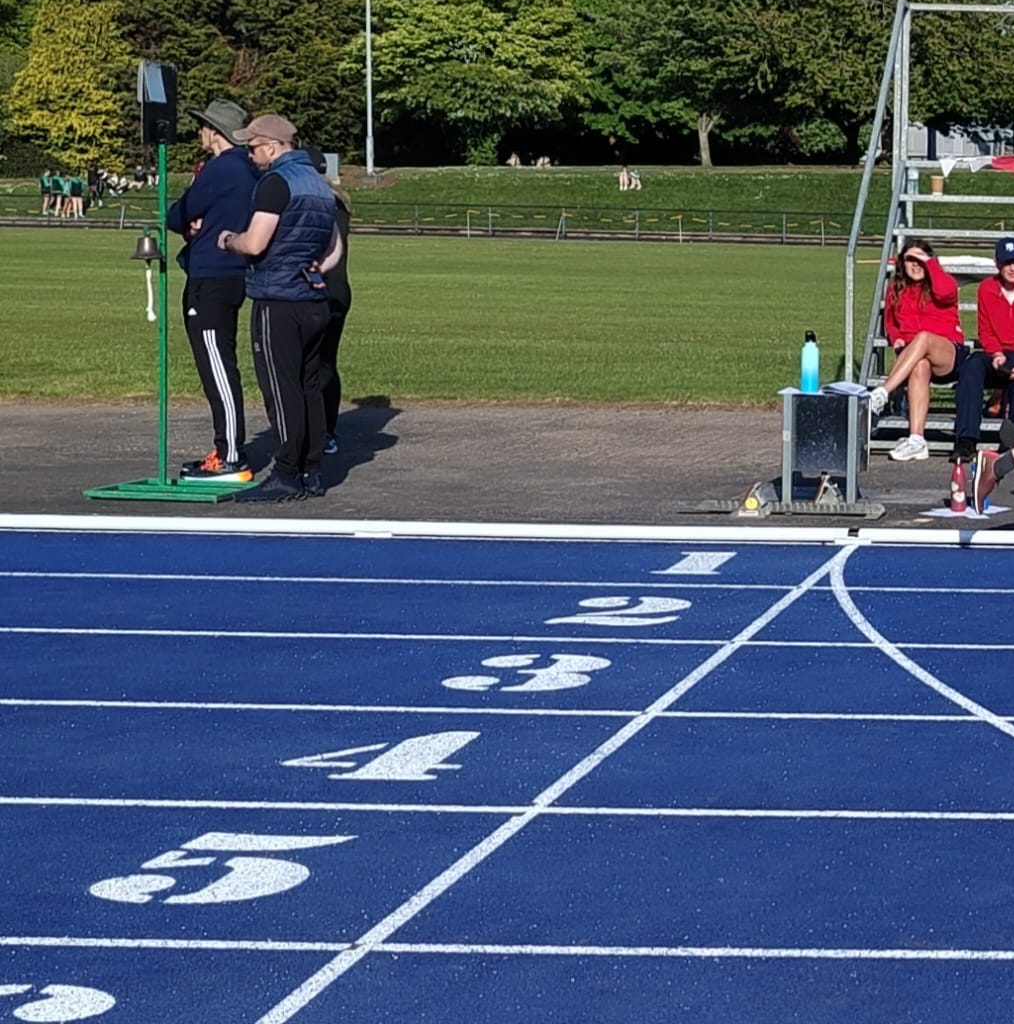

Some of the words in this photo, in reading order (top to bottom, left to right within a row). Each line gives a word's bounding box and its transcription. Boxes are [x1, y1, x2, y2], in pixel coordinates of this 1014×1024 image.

[650, 551, 738, 575] 1
[544, 595, 693, 627] 2
[441, 653, 612, 691] 3
[280, 731, 481, 780] 4
[88, 832, 359, 904] 5
